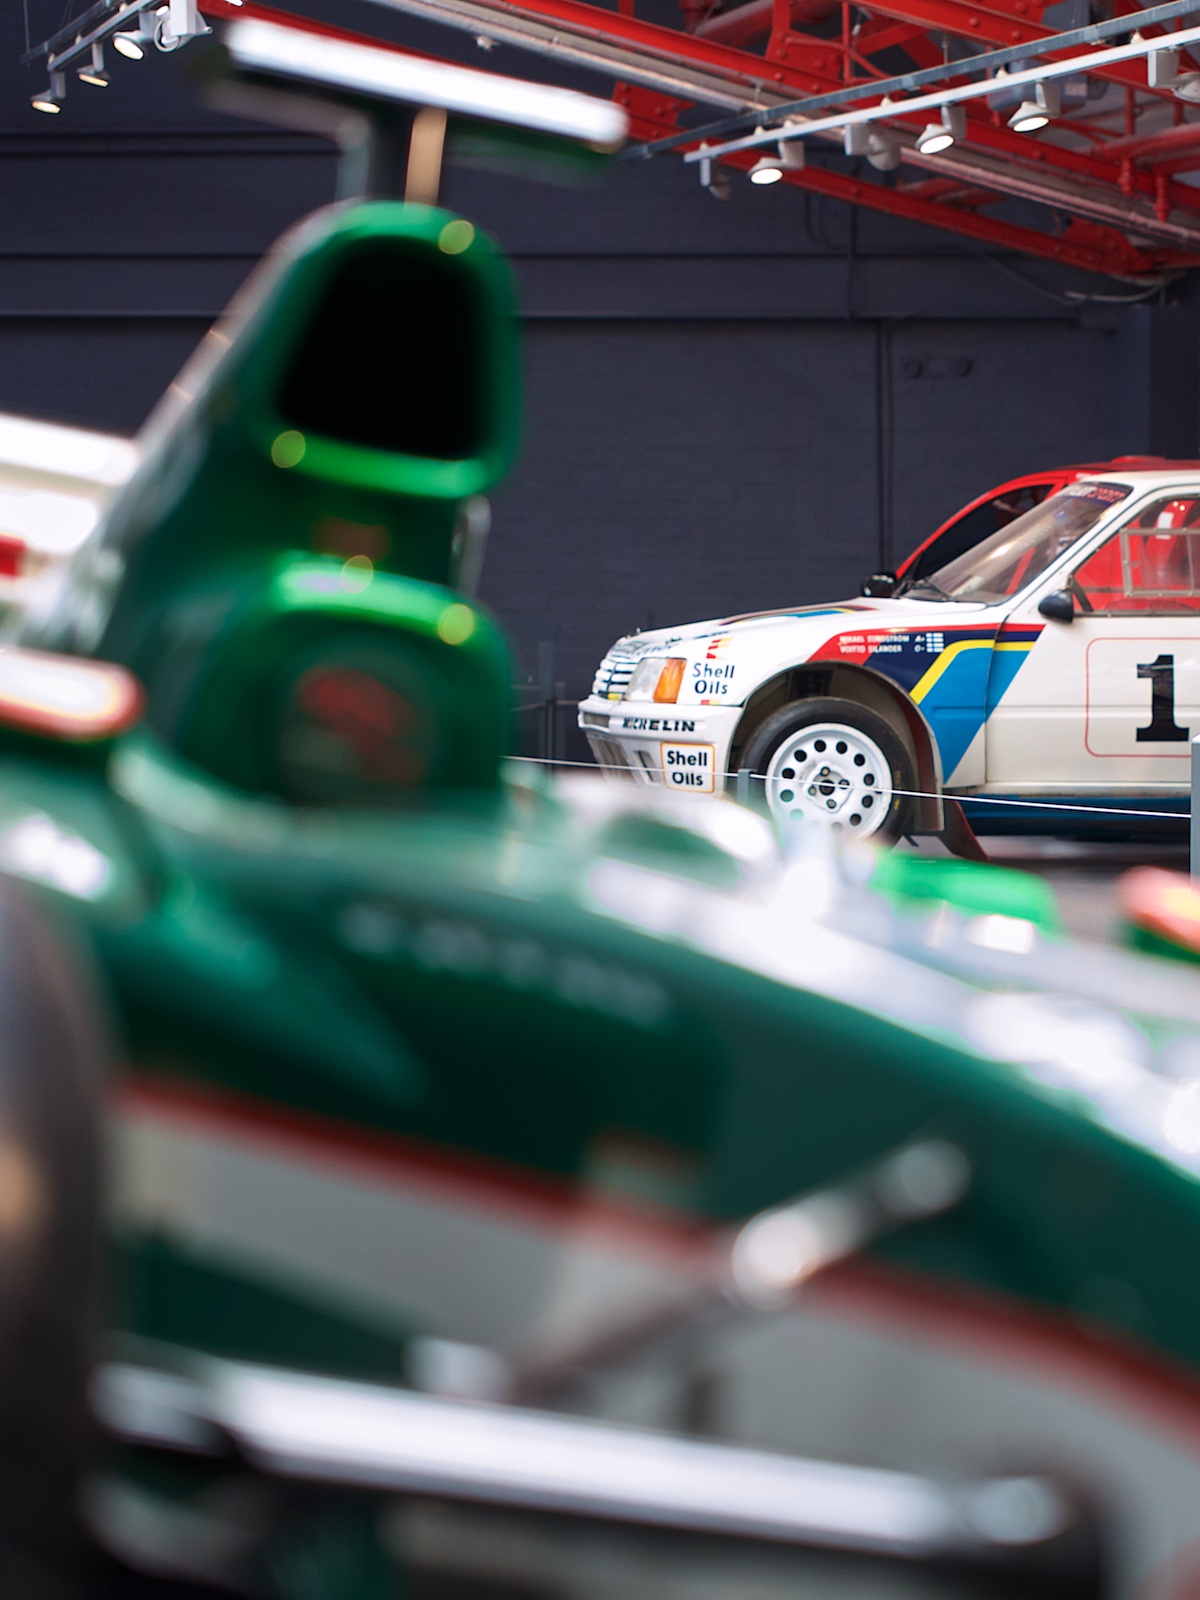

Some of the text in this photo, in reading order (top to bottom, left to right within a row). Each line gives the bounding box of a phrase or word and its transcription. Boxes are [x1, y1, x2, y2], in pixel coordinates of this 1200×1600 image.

[692, 662, 735, 678] Shell
[694, 680, 728, 694] Oils
[1136, 654, 1190, 742] 1
[622, 717, 695, 732] MICHELIN
[667, 750, 707, 766] Shell
[672, 771, 703, 786] Oils
